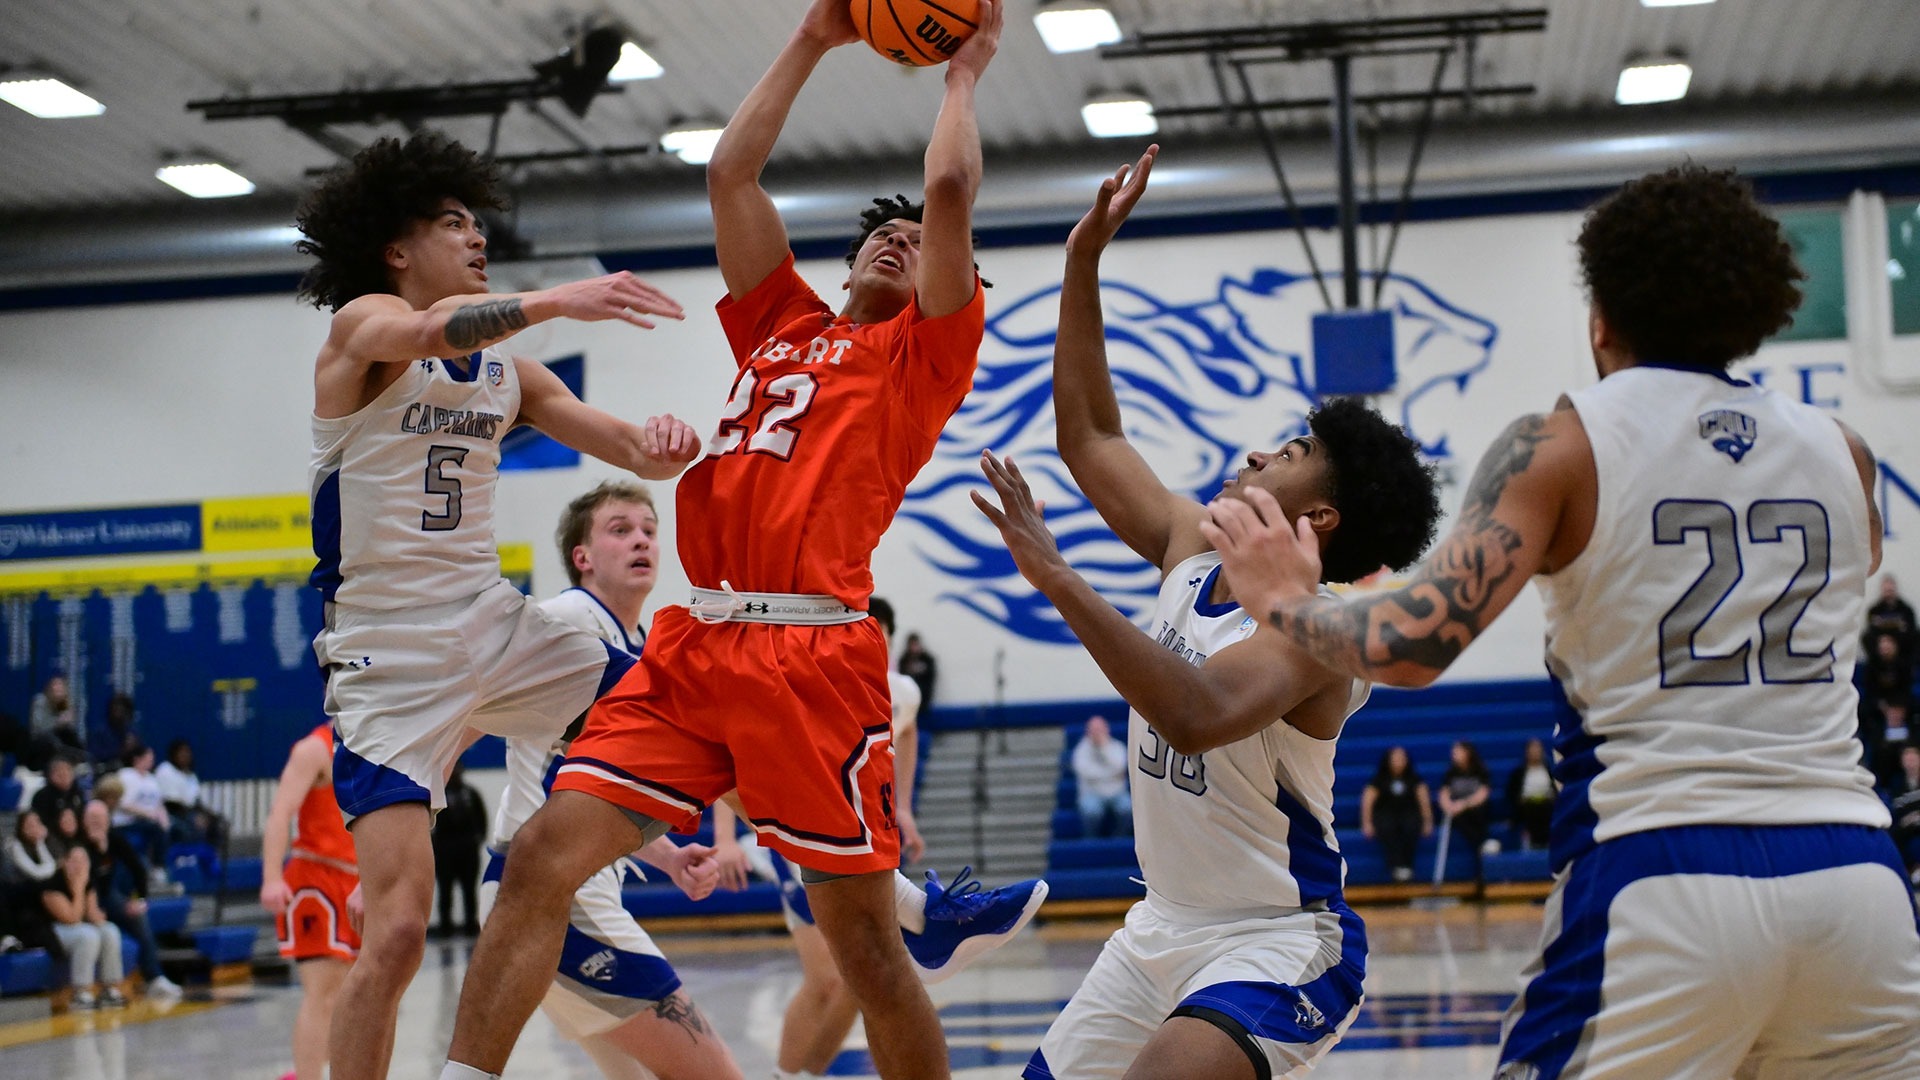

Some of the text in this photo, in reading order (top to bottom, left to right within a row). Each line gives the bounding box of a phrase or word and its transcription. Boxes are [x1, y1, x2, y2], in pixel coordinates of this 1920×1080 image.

[916, 14, 962, 56] Wil
[401, 402, 504, 440] CAPTAINS
[706, 366, 820, 462] 22
[421, 445, 470, 531] 5
[772, 605, 842, 614] UNDER ARMOUR
[1652, 499, 1836, 688] 22
